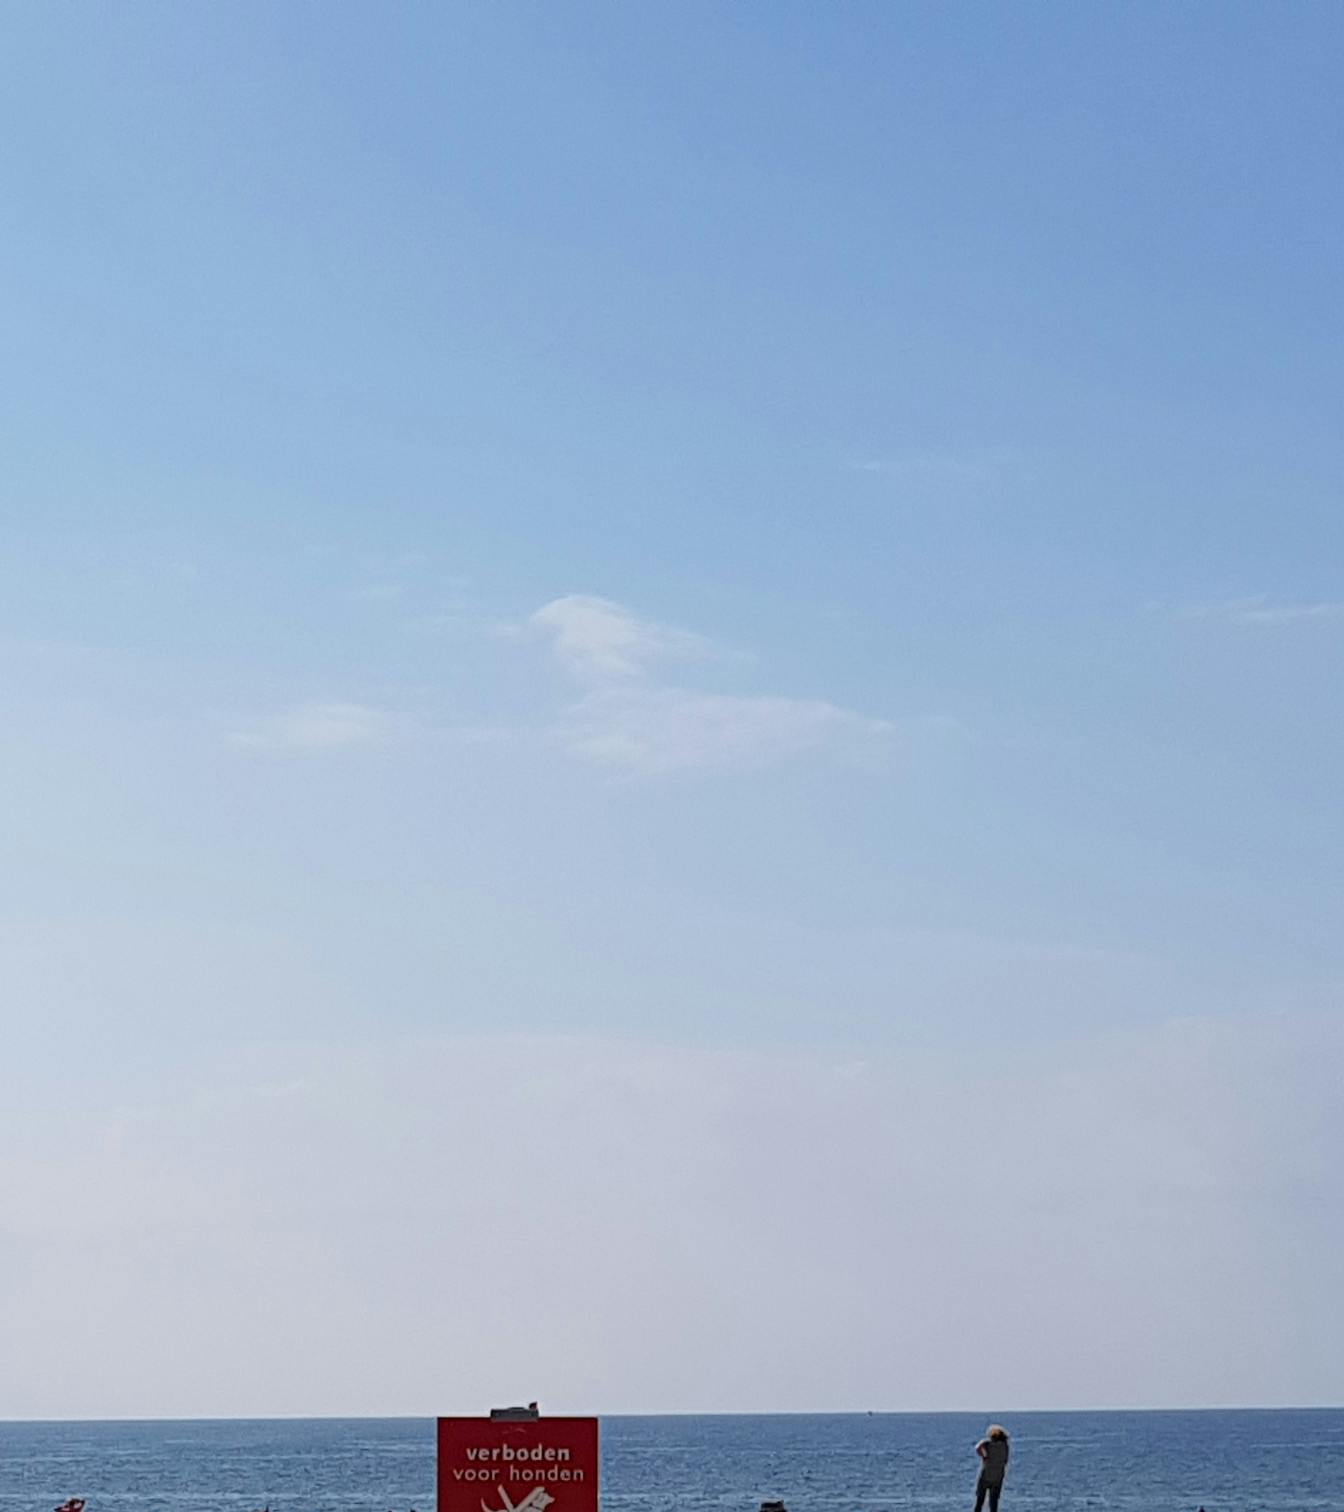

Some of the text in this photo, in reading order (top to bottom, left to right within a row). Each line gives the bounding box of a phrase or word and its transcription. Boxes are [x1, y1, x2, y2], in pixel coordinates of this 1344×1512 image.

[466, 1443, 570, 1461] verboden
[453, 1464, 584, 1481] voor honden
